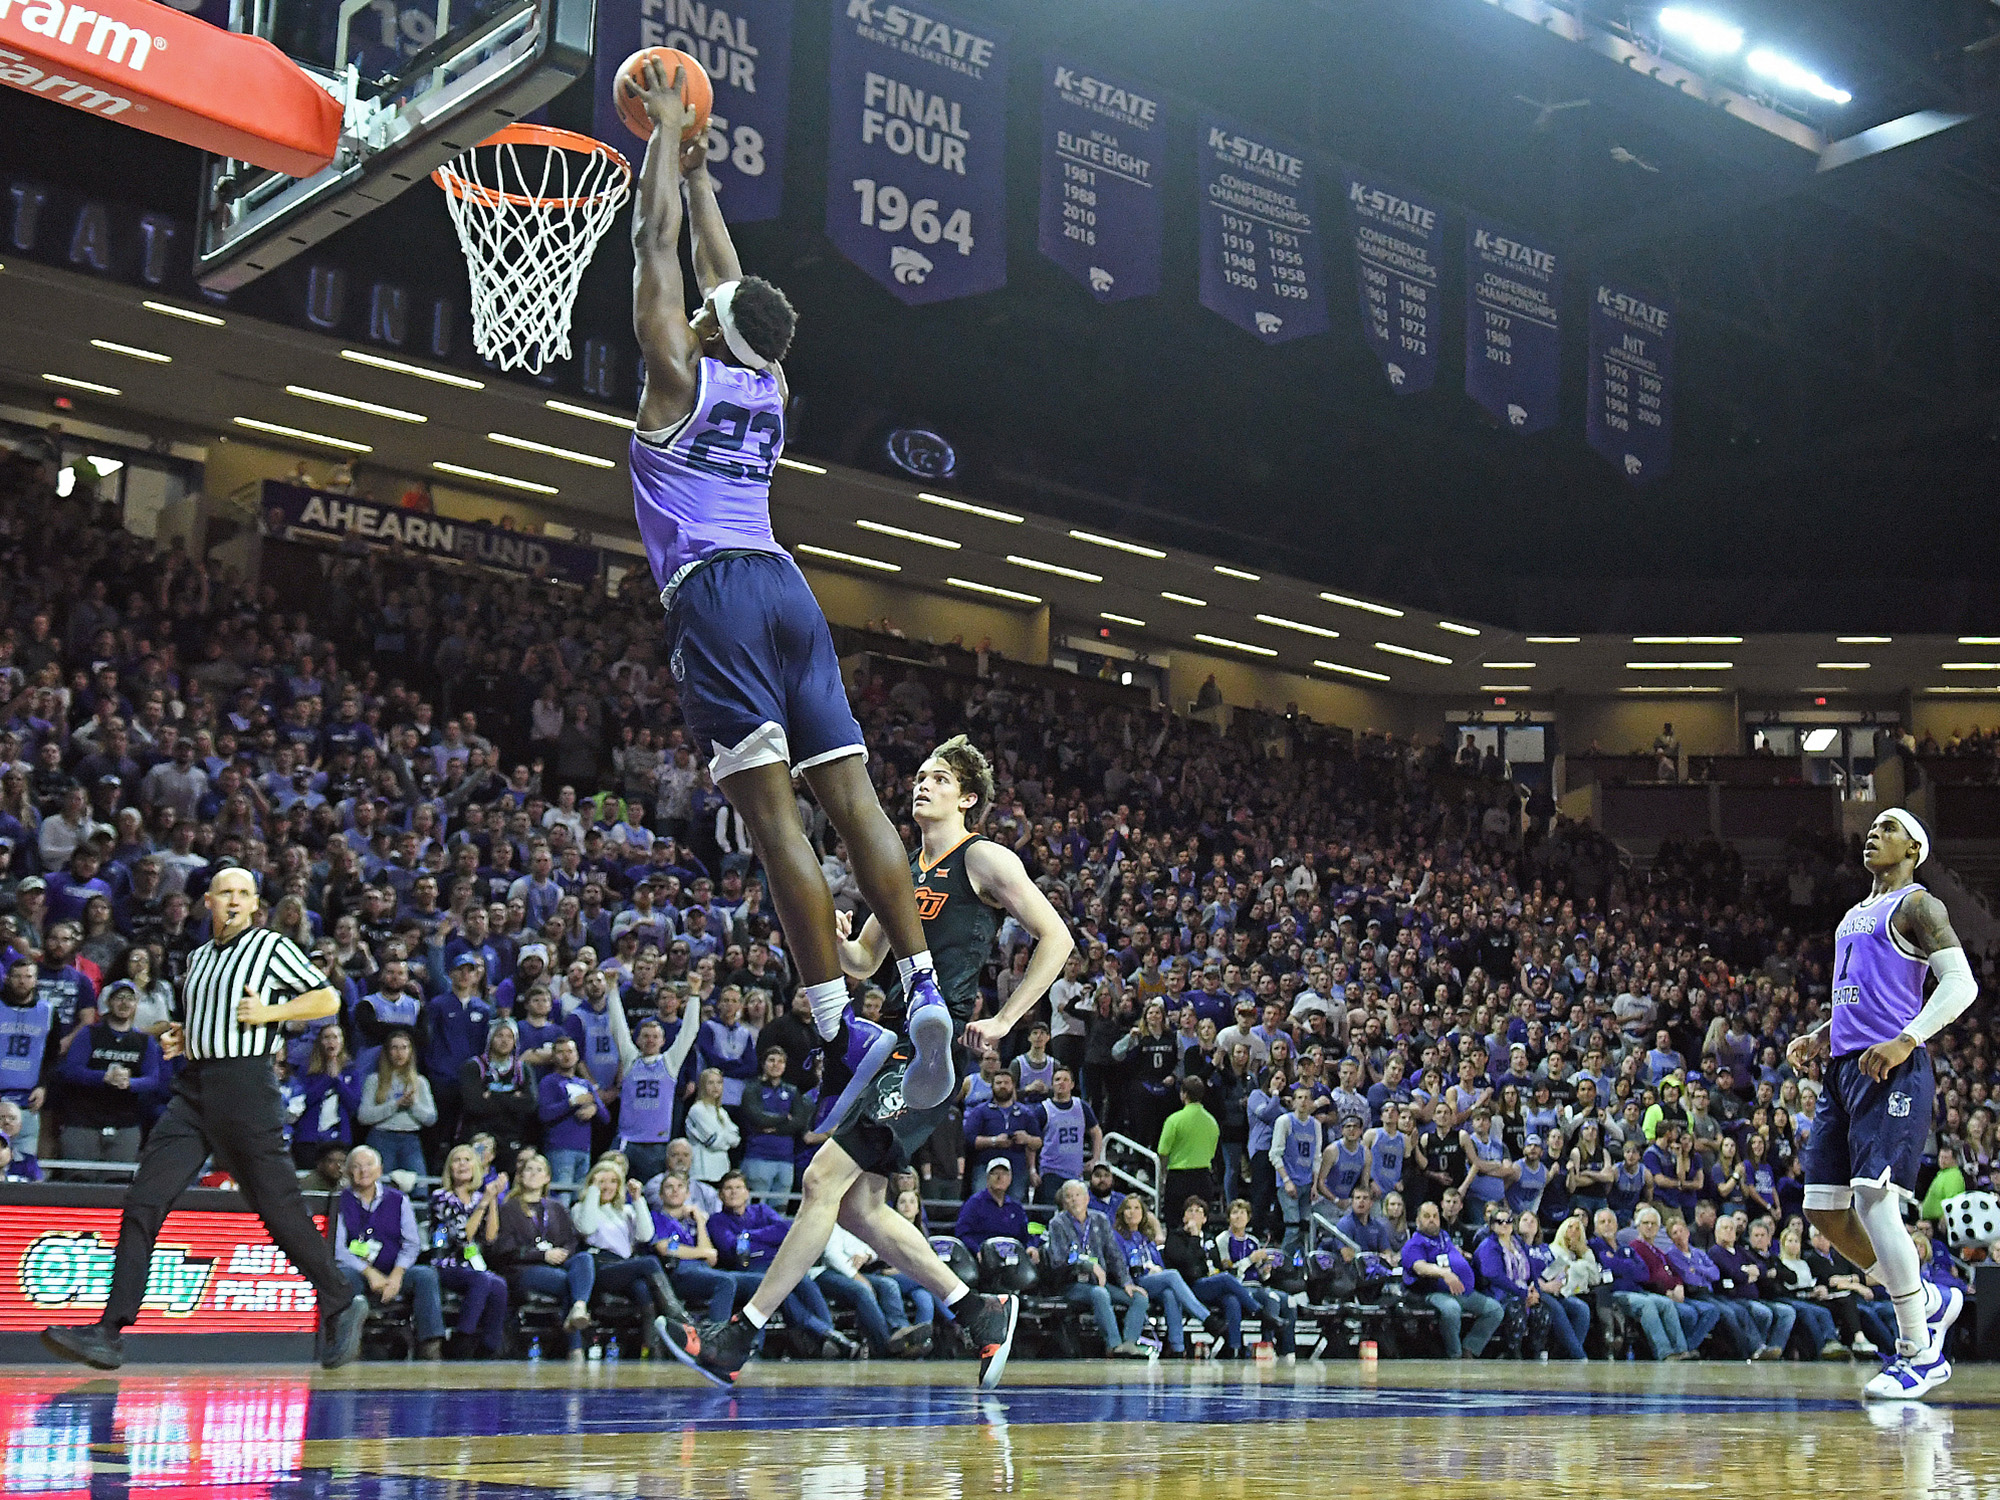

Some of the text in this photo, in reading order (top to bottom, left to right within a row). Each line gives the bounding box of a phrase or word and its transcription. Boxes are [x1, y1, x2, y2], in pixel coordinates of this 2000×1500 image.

[641, 0, 758, 56] FINAL
[846, 0, 994, 67] K-STATE
[641, 18, 756, 93] FOUR
[864, 72, 970, 140] FINAL
[1054, 66, 1157, 122] K-STATE
[862, 109, 966, 175] FOUR
[1057, 130, 1151, 178] ELITE EIGHT
[1208, 127, 1303, 179] K-STATE
[852, 178, 974, 256] 1964
[1063, 201, 1096, 227] 2010
[1221, 214, 1253, 236] 1917
[1349, 181, 1436, 231] K-STATE
[1063, 221, 1096, 246] 2018
[1474, 229, 1556, 273] K-STATE
[1223, 269, 1258, 291] 1950
[1399, 299, 1427, 320] 1970
[1399, 317, 1427, 337] 1972
[1597, 285, 1669, 329] K-STATE
[1399, 335, 1427, 355] 1973
[687, 400, 782, 482] 23
[300, 495, 550, 569] AHEARN FUND
[1838, 942, 1853, 981] 1
[1153, 1052, 1163, 1068] 0
[636, 1080, 659, 1098] 25
[1058, 1127, 1079, 1144] 25
[22, 1235, 214, 1313] O'Rlly
[227, 1244, 298, 1274] AUT
